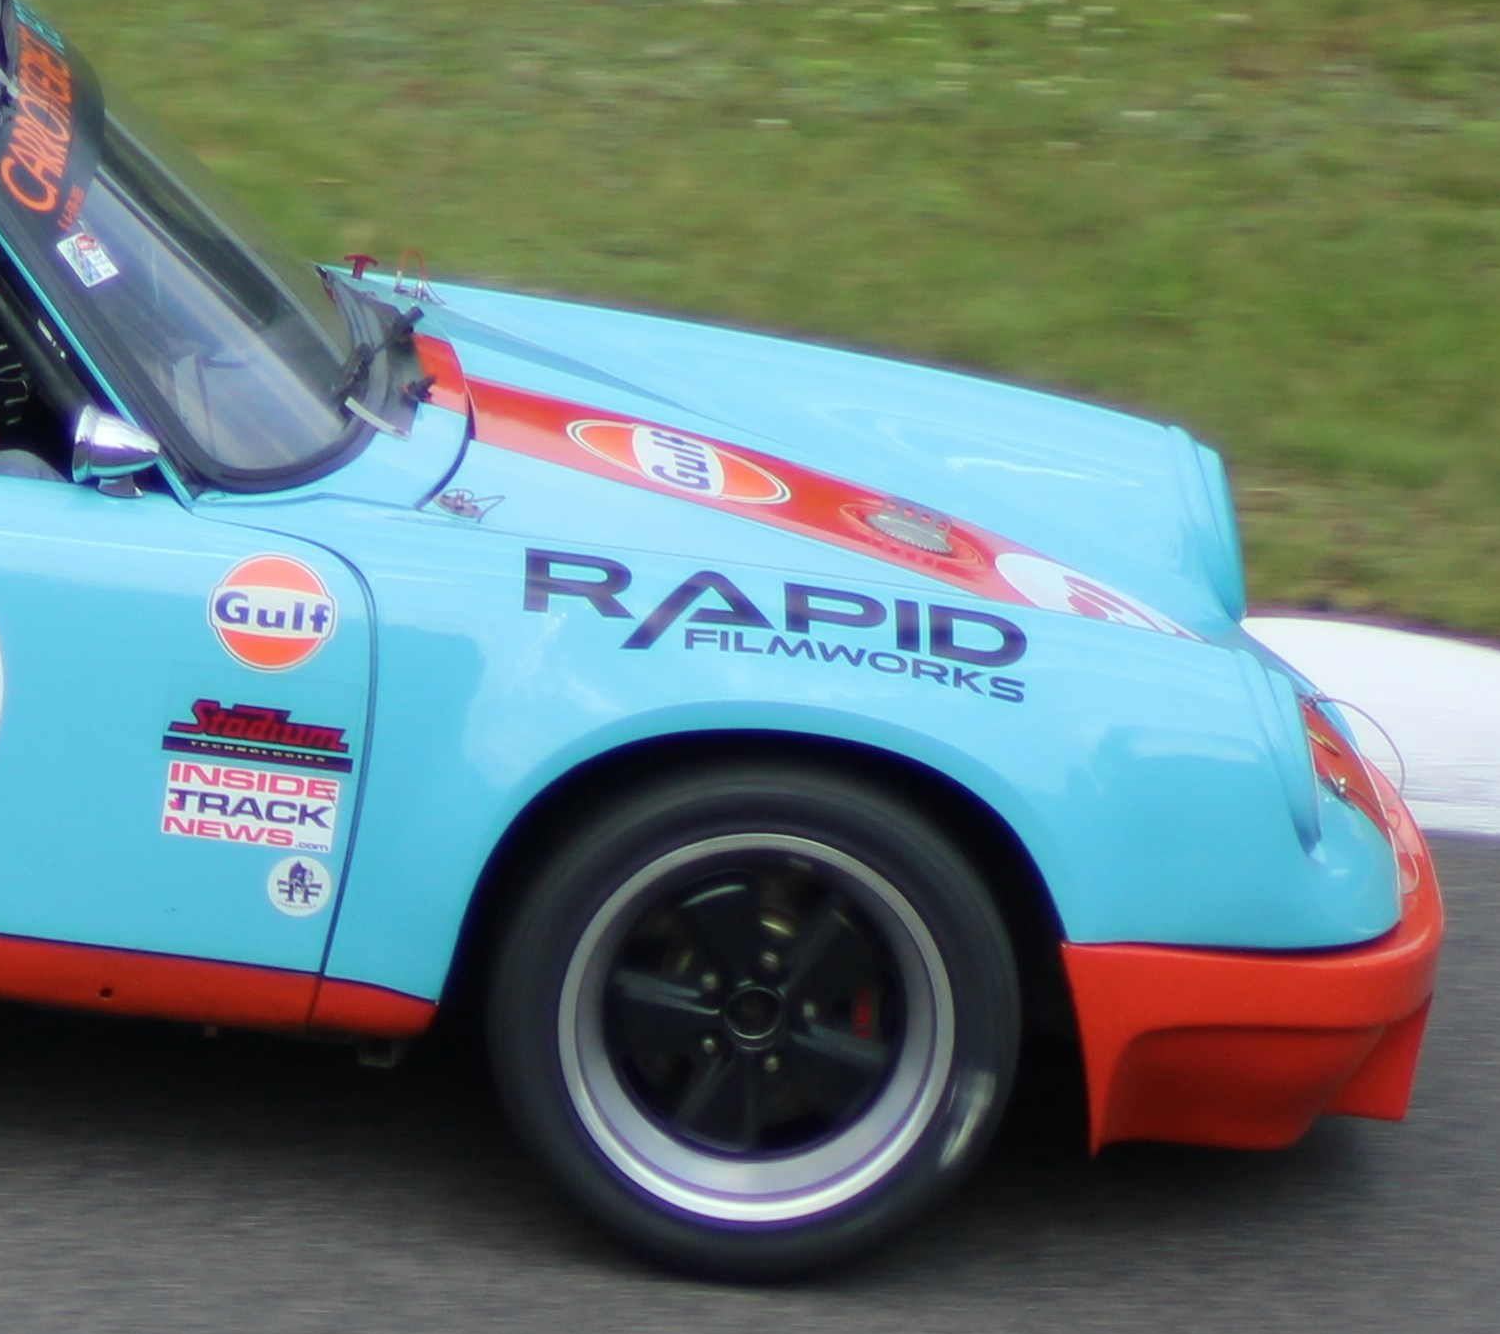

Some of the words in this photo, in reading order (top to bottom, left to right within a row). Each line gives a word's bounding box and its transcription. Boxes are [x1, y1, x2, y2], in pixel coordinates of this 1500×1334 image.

[649, 430, 712, 491] Gulf
[214, 591, 331, 634] Gulf
[523, 547, 1028, 667] RAPID
[684, 628, 1026, 703] FILMWORKS
[168, 698, 349, 754] Stadium
[168, 788, 333, 830] TRACK
[169, 762, 339, 800] INSIDE
